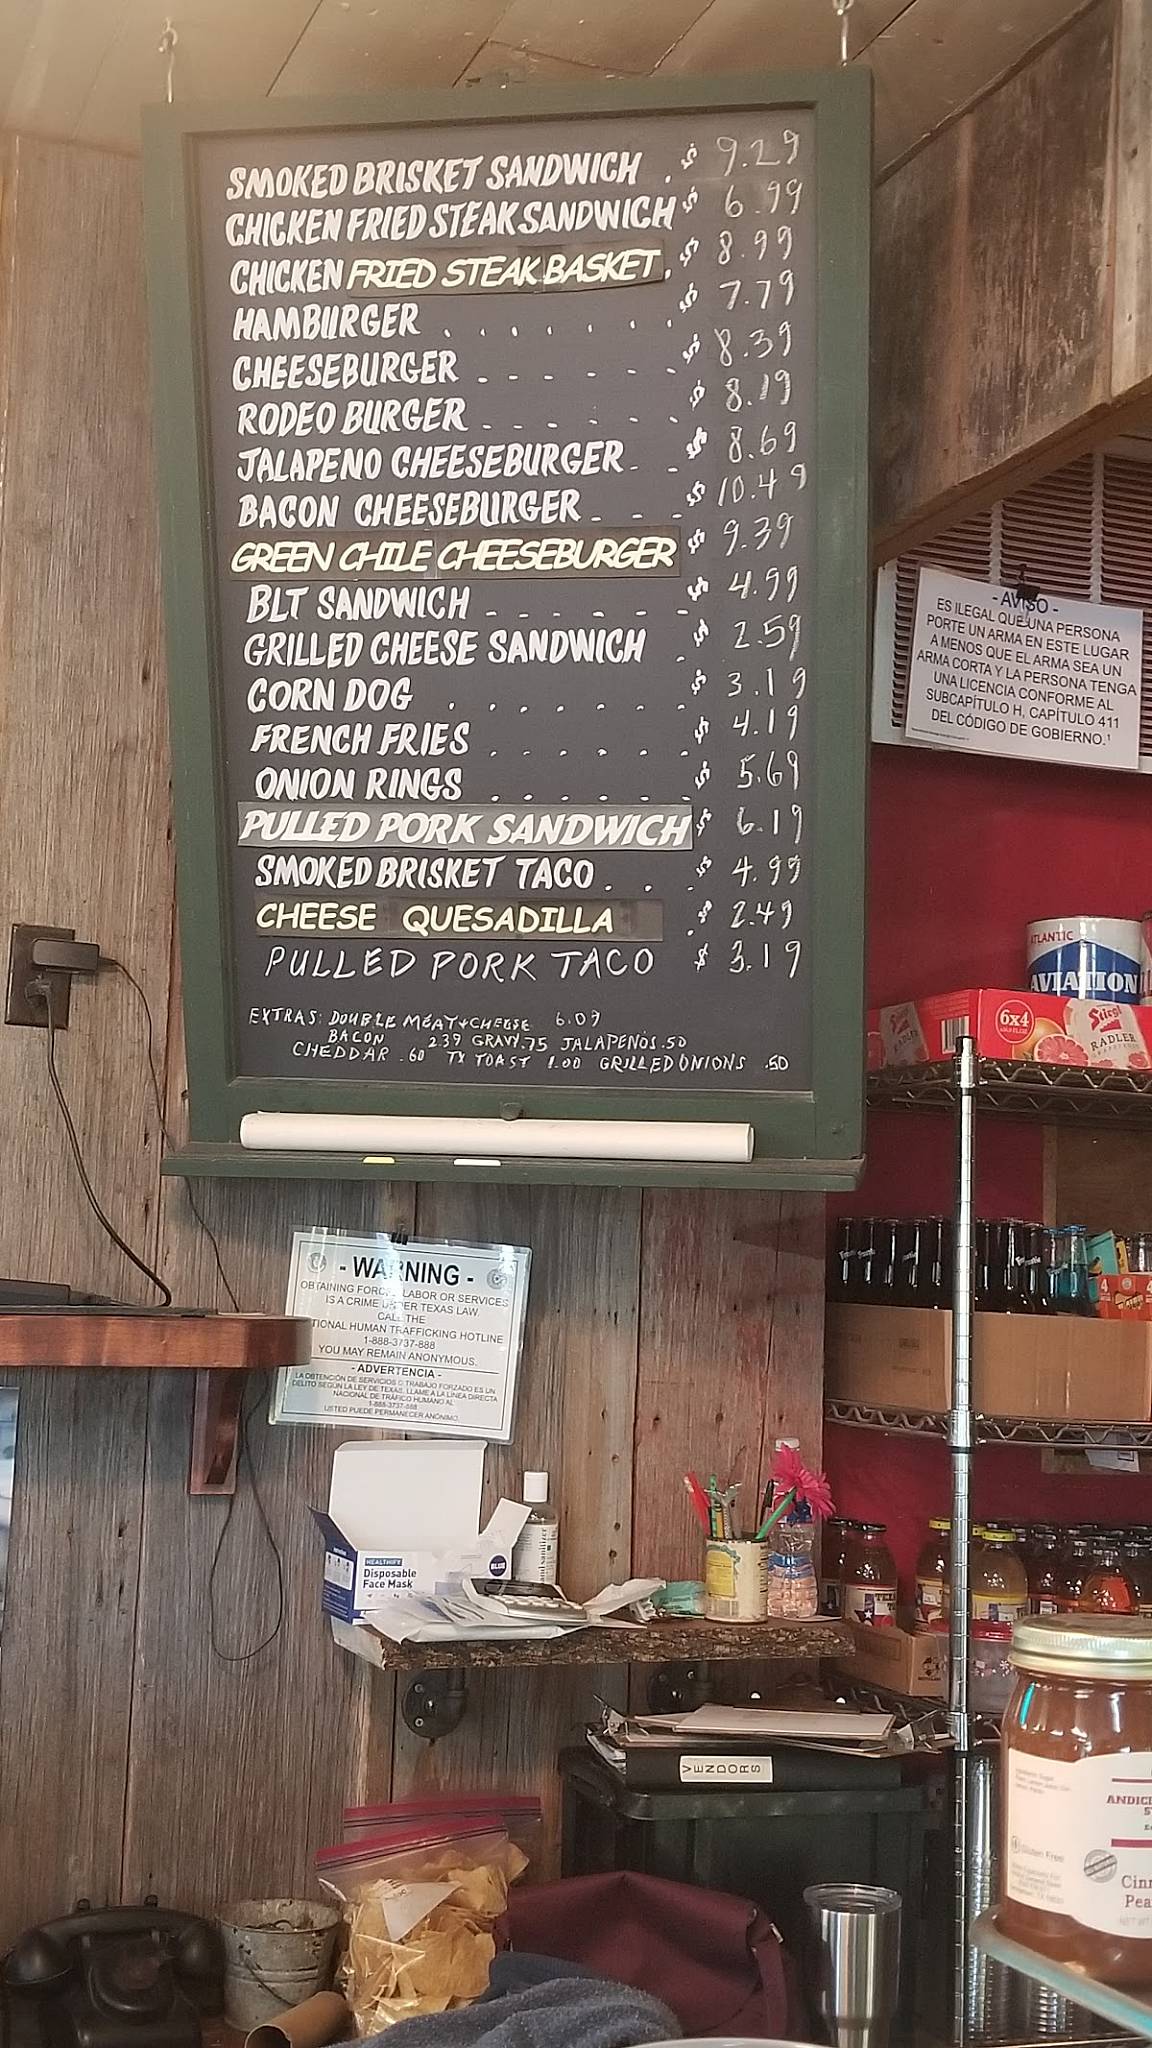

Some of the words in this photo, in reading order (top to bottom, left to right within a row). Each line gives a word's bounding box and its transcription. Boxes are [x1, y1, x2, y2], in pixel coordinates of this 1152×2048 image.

[226, 164, 347, 200] SMOKED
[353, 156, 483, 195] BRISKET
[486, 152, 642, 190] SANDWICH
[226, 209, 343, 246] CHICKEN
[347, 205, 426, 241] FRIED
[429, 201, 519, 238] STEAK
[518, 196, 676, 233] SANDWICH
[230, 259, 344, 296] CHICKEN
[347, 258, 436, 289] FRIED
[442, 256, 542, 287] STEAK
[543, 249, 661, 284] BASKET
[233, 303, 420, 341] HAMBURGER
[233, 350, 459, 391] CHEESEBURGER
[238, 402, 336, 437] RODEO
[341, 398, 468, 434] BURGER
[238, 447, 382, 483] JALAPENO
[392, 440, 623, 478] CHEESEBURGER
[238, 494, 339, 528] BACON
[355, 489, 581, 527] CHEESEBURGER
[231, 542, 335, 572] GREEN
[339, 540, 432, 571] CHILE
[435, 537, 676, 570] CHEESEBURGER
[247, 584, 309, 623] BLT
[317, 586, 469, 620] SANDWICH
[1000, 591, 1049, 613] AVISO
[926, 612, 967, 635] PORTE
[968, 623, 986, 639] UN
[986, 628, 1023, 646] ARMA
[1025, 634, 1043, 650] EN
[1045, 638, 1081, 655] ESTE
[1082, 643, 1130, 661] LUGAR
[937, 598, 952, 612] ES
[954, 602, 996, 623] ILEGAL
[998, 611, 1027, 627] QUE
[1028, 618, 1055, 634] UNA
[1056, 622, 1121, 643] PERSONA
[371, 630, 478, 665] CHEESE
[488, 629, 646, 663] SANDWICH
[930, 633, 939, 647] A
[940, 635, 983, 656] MENOS
[985, 645, 1014, 662] QUE
[1015, 651, 1031, 665] EL
[1032, 651, 1071, 672] ARMA
[1072, 660, 1100, 675] SEA
[1102, 664, 1122, 677] UN
[916, 649, 950, 668] ARMA
[952, 656, 993, 676] CORTA
[994, 665, 1004, 678] Y
[1006, 667, 1022, 681] LA
[1023, 670, 1088, 691] PERSONA
[1089, 678, 1137, 696] TENGA
[248, 678, 334, 713] CORN
[343, 677, 413, 711] DOG
[926, 687, 1010, 717] SUBCAPÍTULO
[1029, 705, 1097, 727] CAPÍTULO
[1096, 715, 1119, 728] 411
[934, 670, 959, 689] UNA
[959, 676, 1017, 698] LICENCIA
[1018, 687, 1095, 709] CONFORME
[1096, 698, 1114, 711] AL
[250, 723, 372, 755] FRENCH
[377, 722, 469, 756] FRIES
[931, 708, 955, 724] DEL
[955, 712, 1007, 733] CÓDIGO
[1010, 722, 1028, 736] DE
[256, 767, 355, 800] ONION
[365, 768, 461, 800] RINGS
[241, 810, 371, 842] PULLED
[375, 812, 477, 844] PORK
[487, 814, 691, 847] SANDWICH
[255, 855, 372, 888] SMOKED
[375, 856, 505, 888] BRISKET
[516, 858, 593, 889] TACO
[257, 903, 376, 930] CHEESE
[403, 905, 612, 936] QUESADILLA
[265, 947, 415, 978] PULLED
[432, 951, 536, 982] PORK
[551, 948, 653, 978] TACO
[1031, 971, 1138, 995] AVIATION
[328, 1011, 396, 1029] DOUBLE
[1000, 1009, 1030, 1027] 6x4
[328, 1029, 384, 1045] BACON
[1091, 1032, 1137, 1051] RADLER
[293, 1042, 389, 1061] CHEDDAR
[447, 1051, 465, 1064] TX
[475, 1053, 530, 1069] TOAST
[301, 1281, 355, 1293] OBTAINING
[403, 1288, 437, 1301] LABOR
[439, 1292, 455, 1301] OR
[457, 1294, 509, 1308] SERVICES
[325, 1294, 336, 1304] IS
[336, 1295, 345, 1306] A
[345, 1296, 379, 1308] CRIME
[420, 1302, 455, 1315] TEXAS
[349, 1321, 388, 1335] HUMAN
[458, 1330, 504, 1345] HOTLINE
[405, 1314, 426, 1324] THE
[318, 1344, 341, 1356] YOU
[342, 1346, 364, 1357] MAY
[366, 1348, 404, 1361] REMAIN
[357, 1364, 435, 1379] ADVERTENCIA
[363, 1568, 417, 1580] Disposable
[363, 1579, 385, 1588] Face
[388, 1579, 413, 1588] Mask
[683, 1764, 761, 1774] VENDORS
